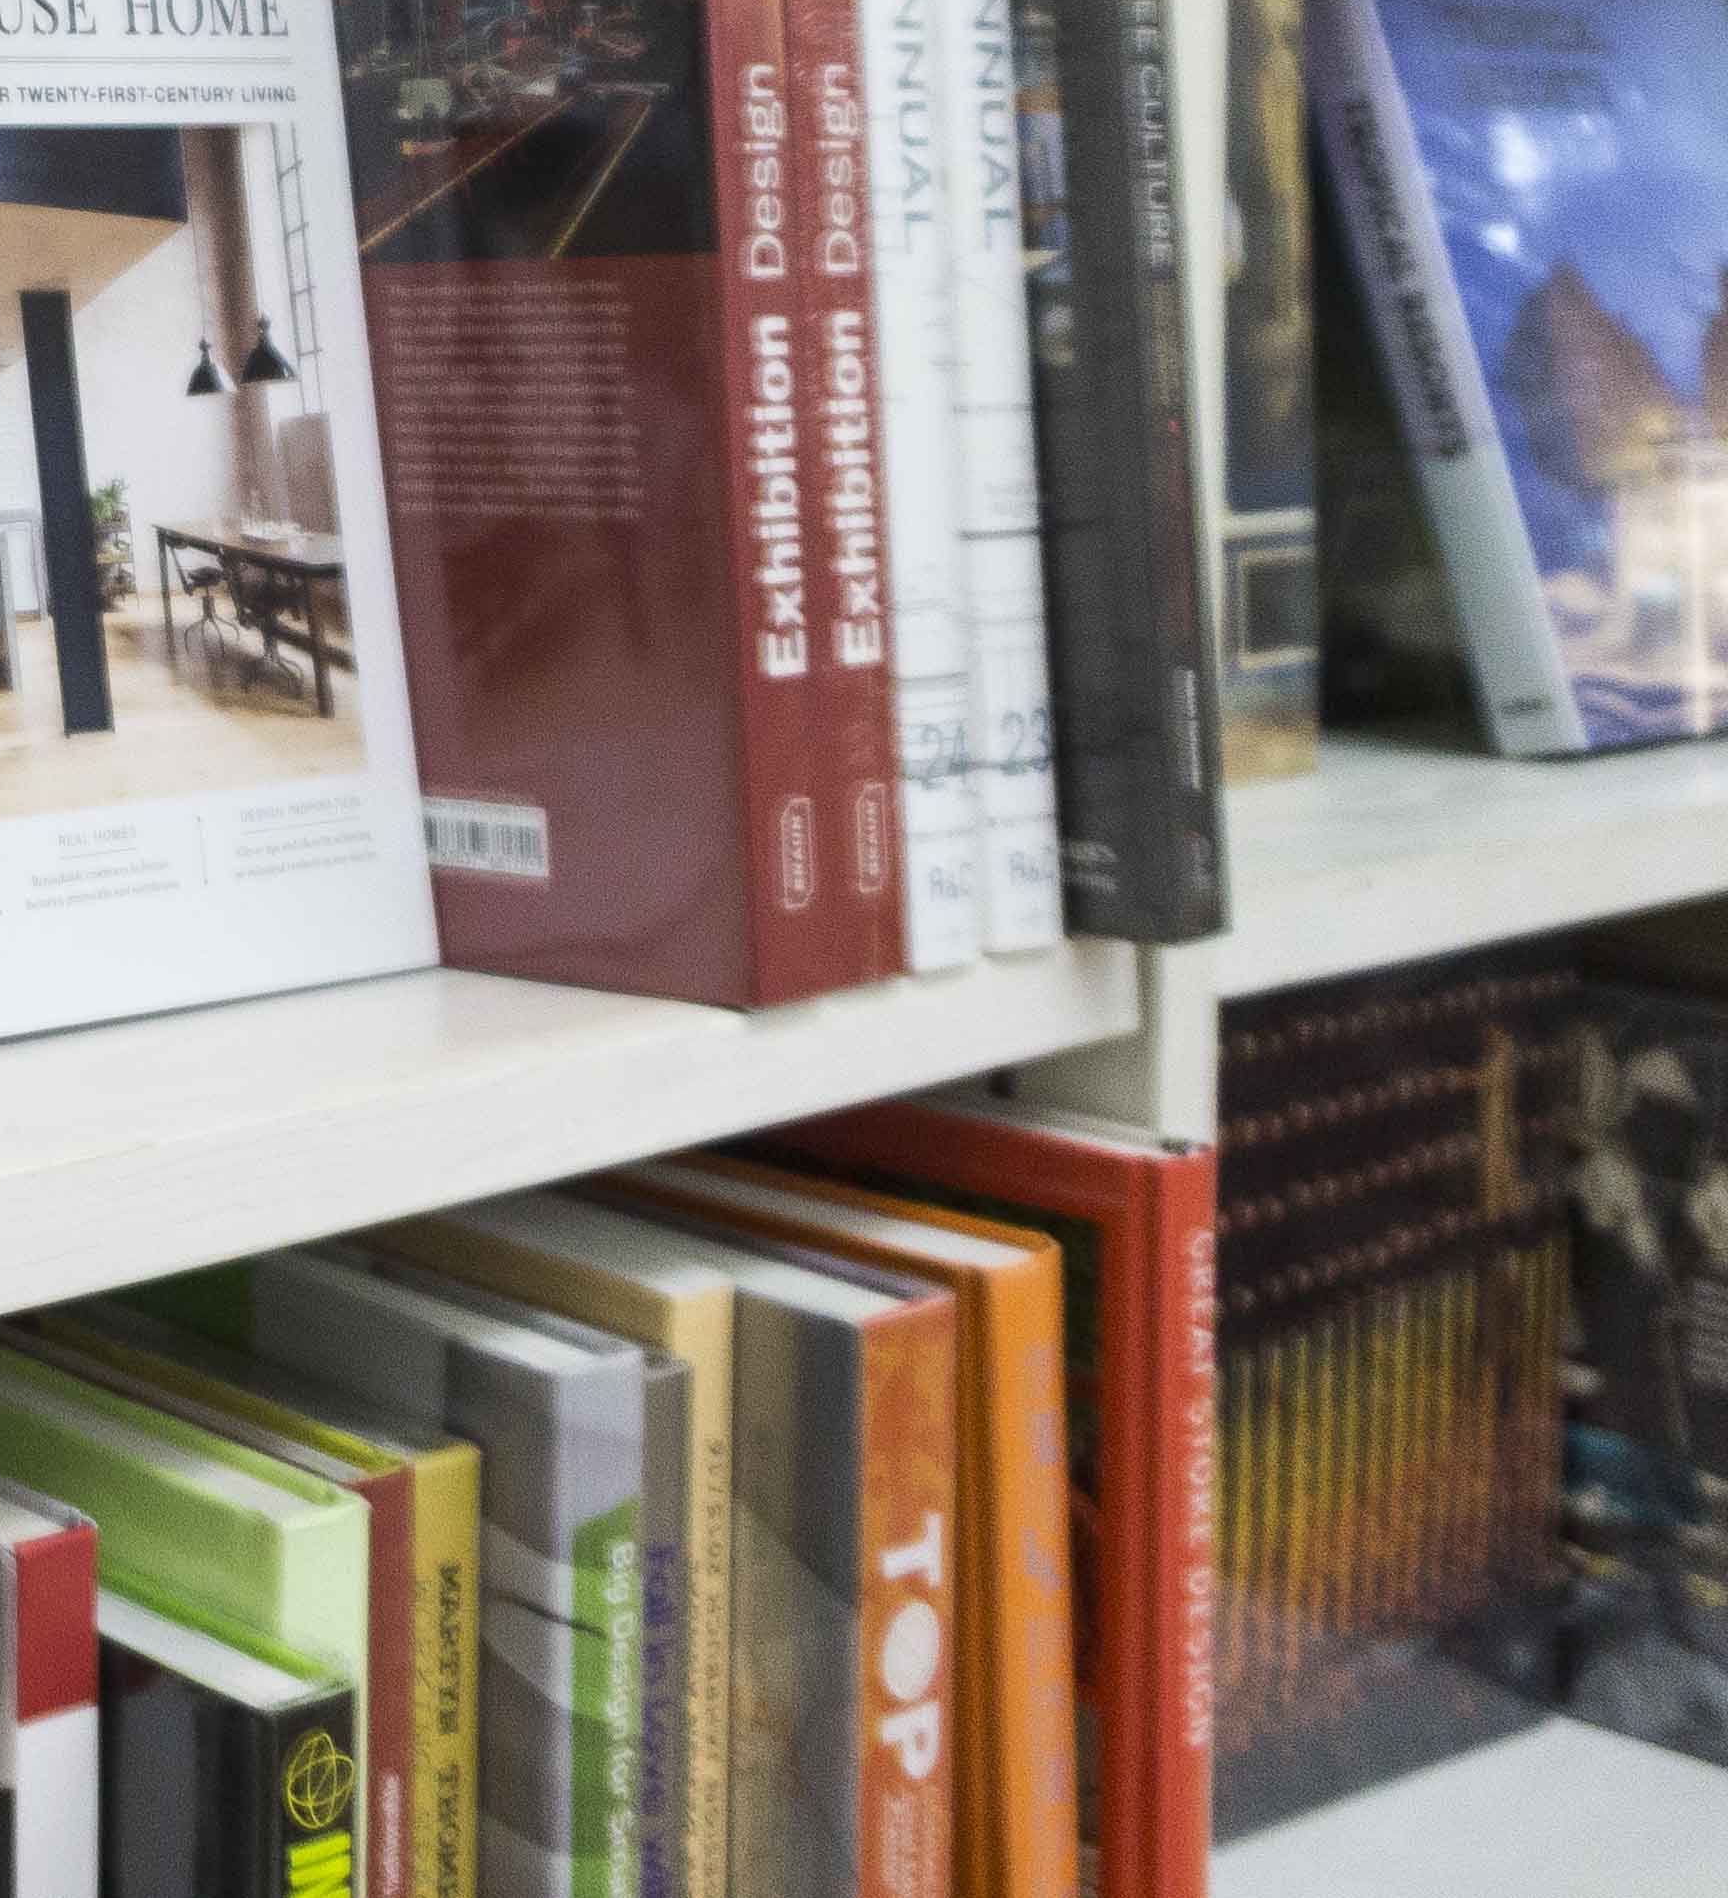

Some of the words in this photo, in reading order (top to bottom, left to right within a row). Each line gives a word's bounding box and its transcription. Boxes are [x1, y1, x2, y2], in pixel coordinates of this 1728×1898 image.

[18, 85, 234, 104] TWENTY-FIRST-CENTURY
[241, 86, 297, 103] LIVING
[744, 63, 786, 280] Design
[825, 63, 862, 277] Design
[1134, 65, 1175, 266] CULTURE
[753, 314, 808, 679] Exhibition
[824, 310, 882, 667] Exhibition
[605, 1613, 637, 1739] Design
[880, 1511, 941, 1779] TOP
[1184, 1565, 1210, 1745] DESIGN
[610, 1748, 637, 1797] for
